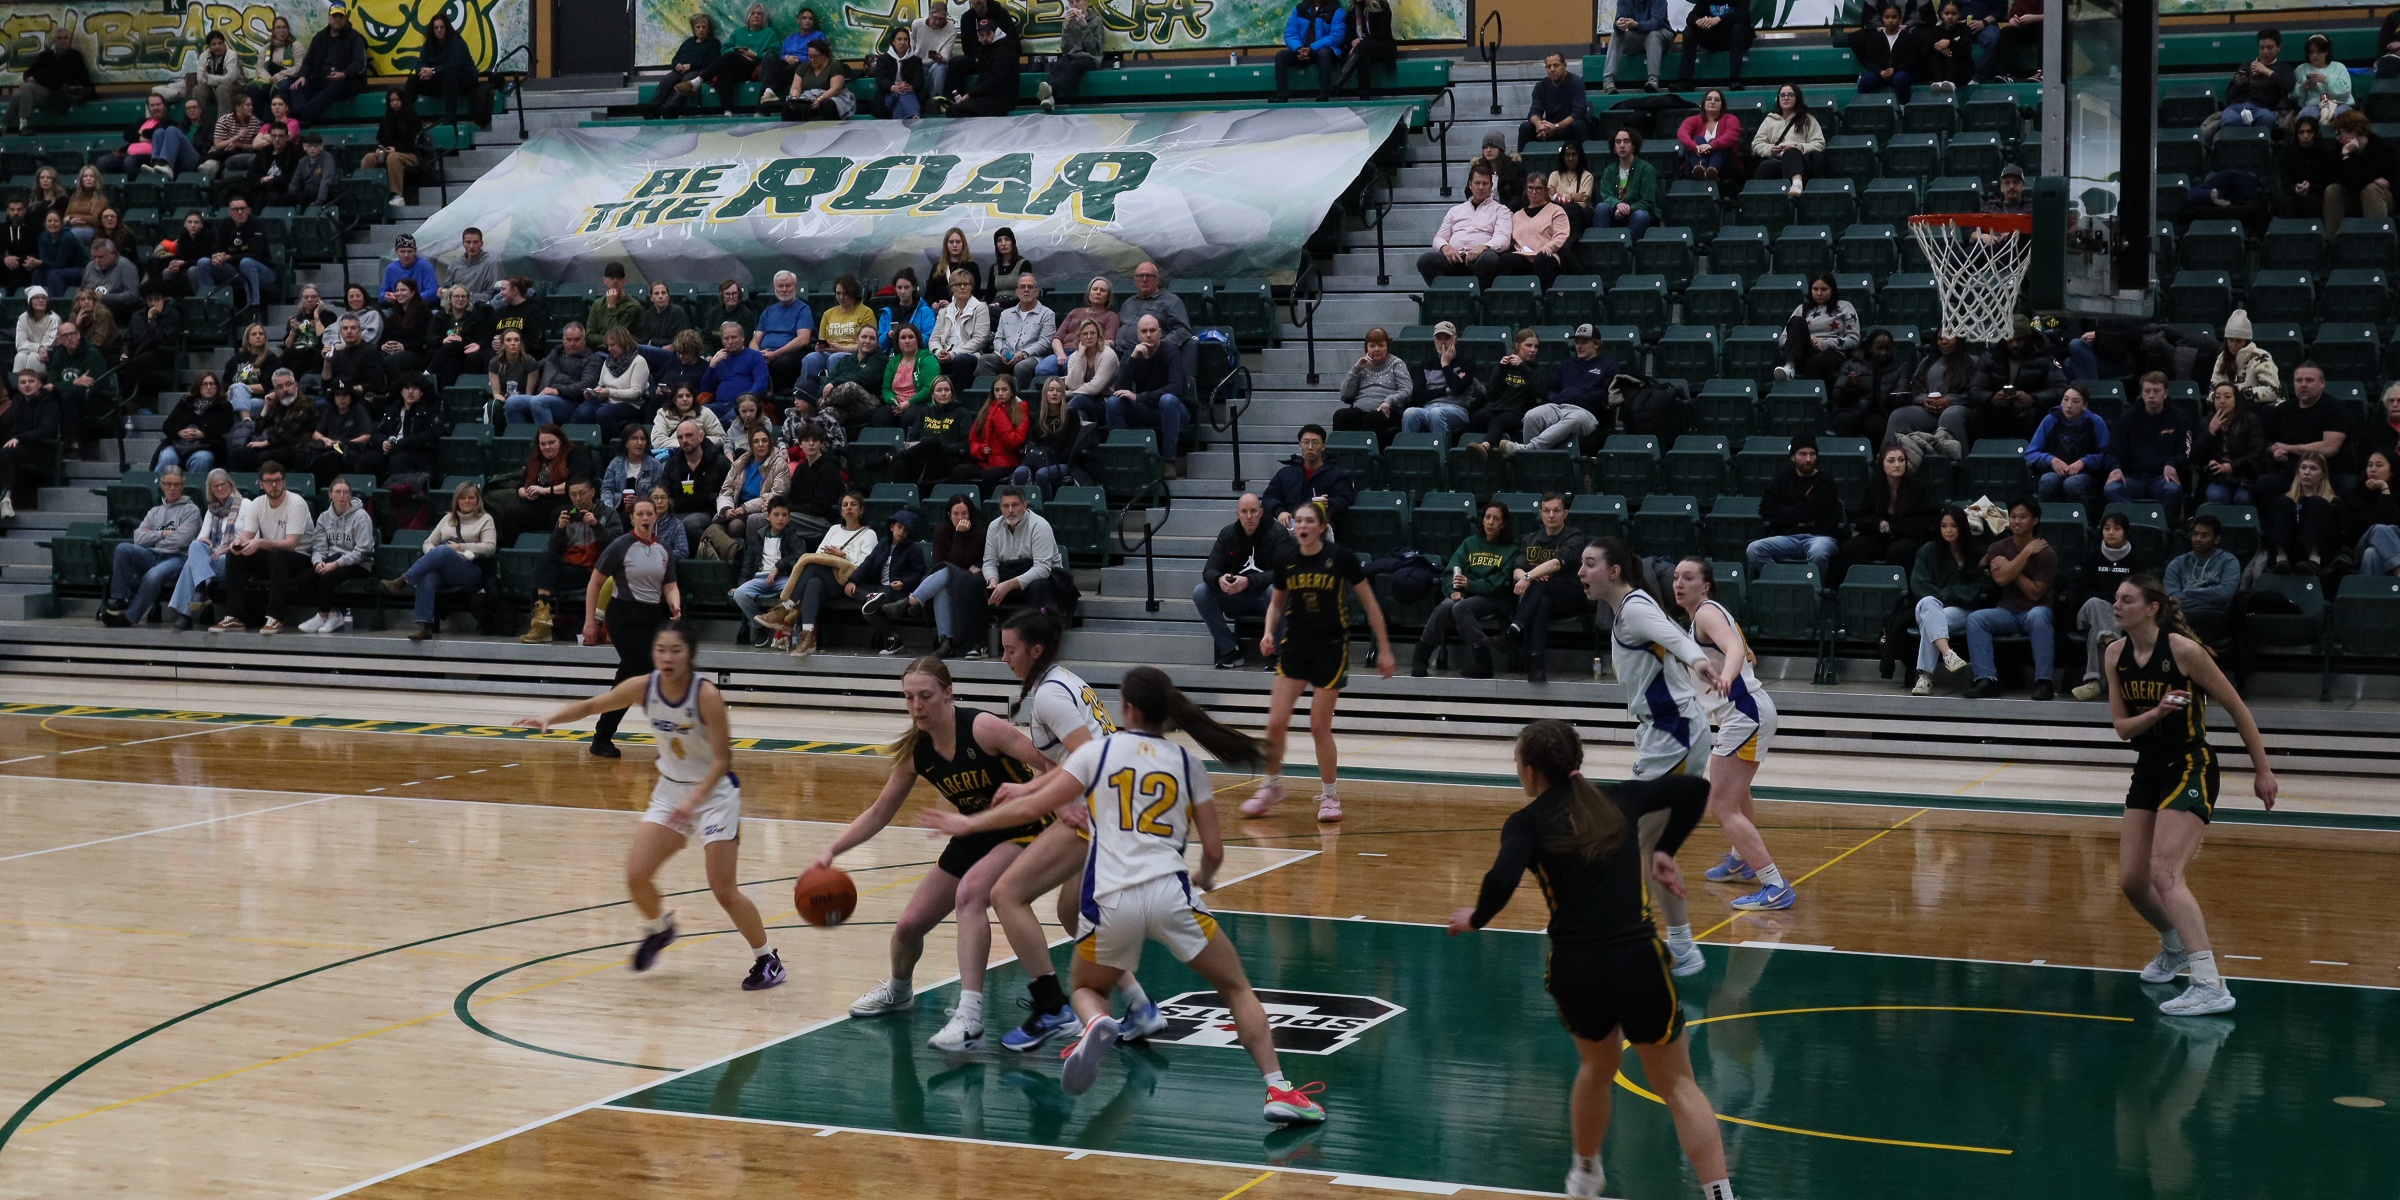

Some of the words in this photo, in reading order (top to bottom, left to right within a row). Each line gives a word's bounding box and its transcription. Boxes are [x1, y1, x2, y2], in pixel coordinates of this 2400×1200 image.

[84, 1, 276, 72] BEARS
[624, 164, 740, 199] BE
[707, 151, 1158, 225] ROAR
[574, 194, 712, 236] THE
[828, 327, 855, 336] BAUER
[829, 321, 855, 329] EDDIE
[1108, 767, 1178, 837] 12
